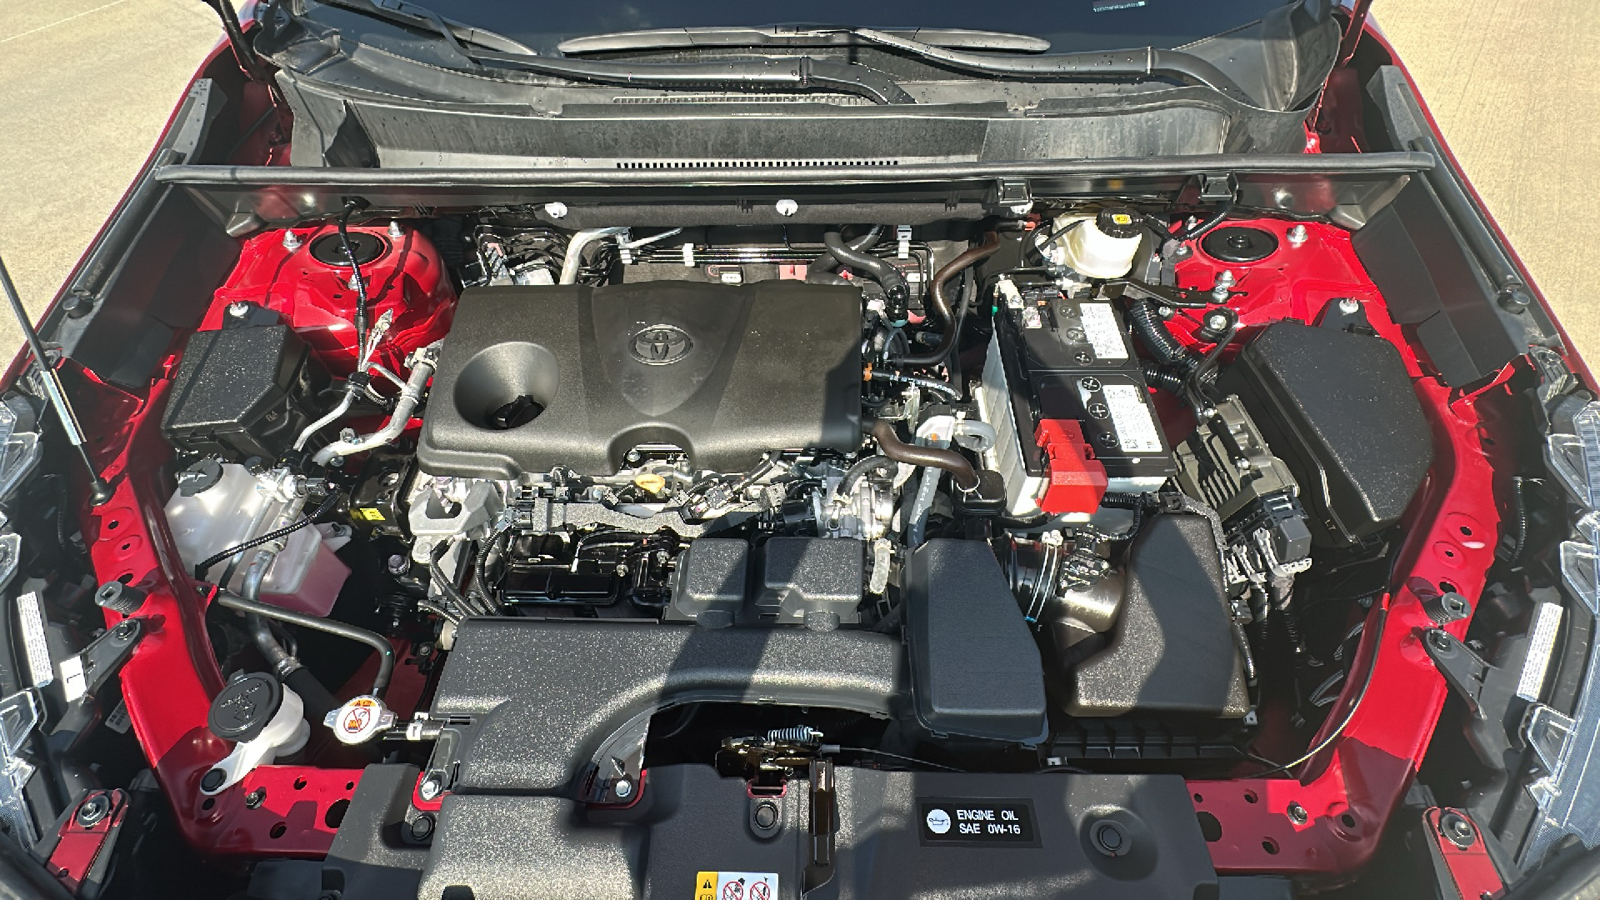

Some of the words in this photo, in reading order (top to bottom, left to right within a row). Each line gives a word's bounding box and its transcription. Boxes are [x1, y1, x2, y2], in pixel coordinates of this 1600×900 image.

[956, 809, 996, 821] ENGINE
[1001, 810, 1019, 821] OIL
[959, 823, 981, 834] SAE
[987, 824, 1021, 835] 0W-16
